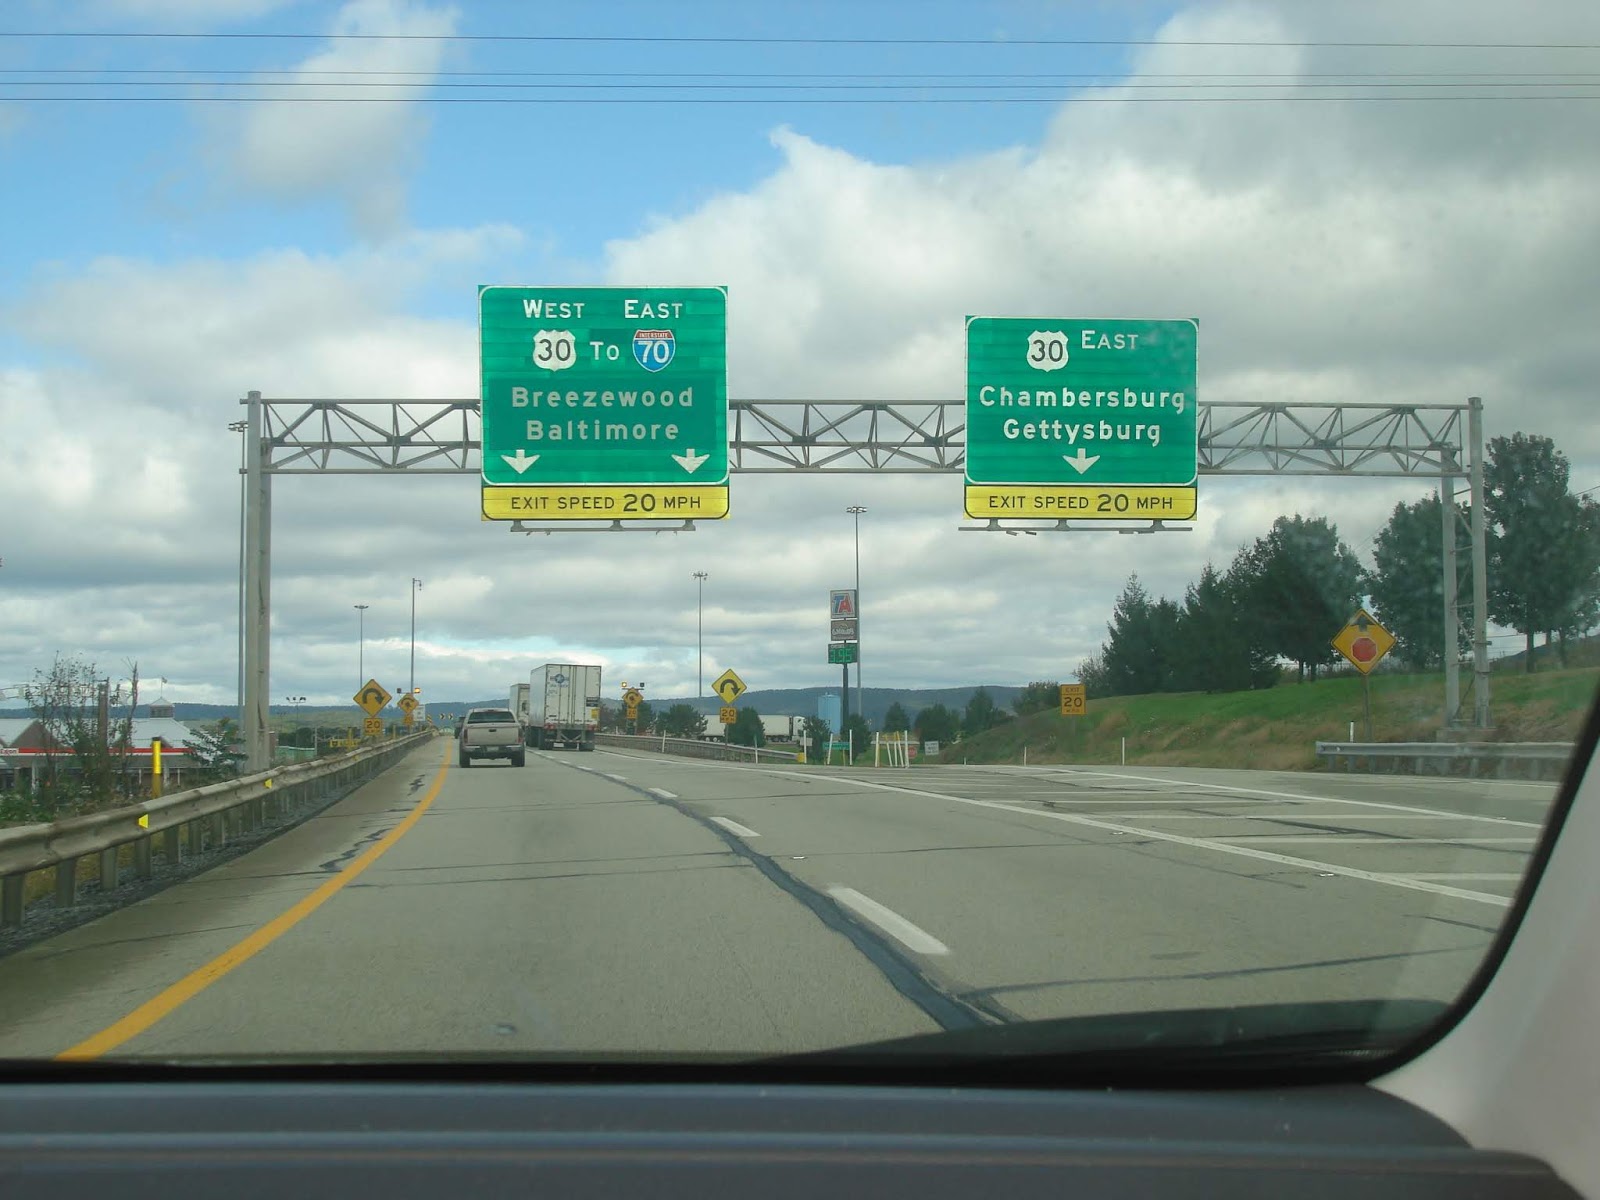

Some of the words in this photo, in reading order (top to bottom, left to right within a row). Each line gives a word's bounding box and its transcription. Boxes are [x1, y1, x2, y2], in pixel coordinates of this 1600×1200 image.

[537, 338, 571, 361] 30
[636, 340, 670, 363] 70
[1031, 339, 1063, 362] 30
[512, 387, 693, 407] Breezewood
[980, 386, 1185, 414] Chambersburg
[527, 420, 679, 440] Baltimore
[1003, 418, 1160, 447] Gettysburg
[511, 497, 548, 510] EXIT
[558, 497, 615, 510] SPEED
[623, 493, 656, 512] 20
[664, 496, 701, 509] MPH
[989, 496, 1026, 508] EXIT
[1034, 496, 1089, 509] SPEED
[1097, 494, 1129, 512] 20
[1137, 497, 1173, 509] MPH
[832, 594, 853, 614] TA
[1064, 696, 1082, 707] 20
[721, 709, 735, 717] 20
[366, 720, 381, 729] 20
